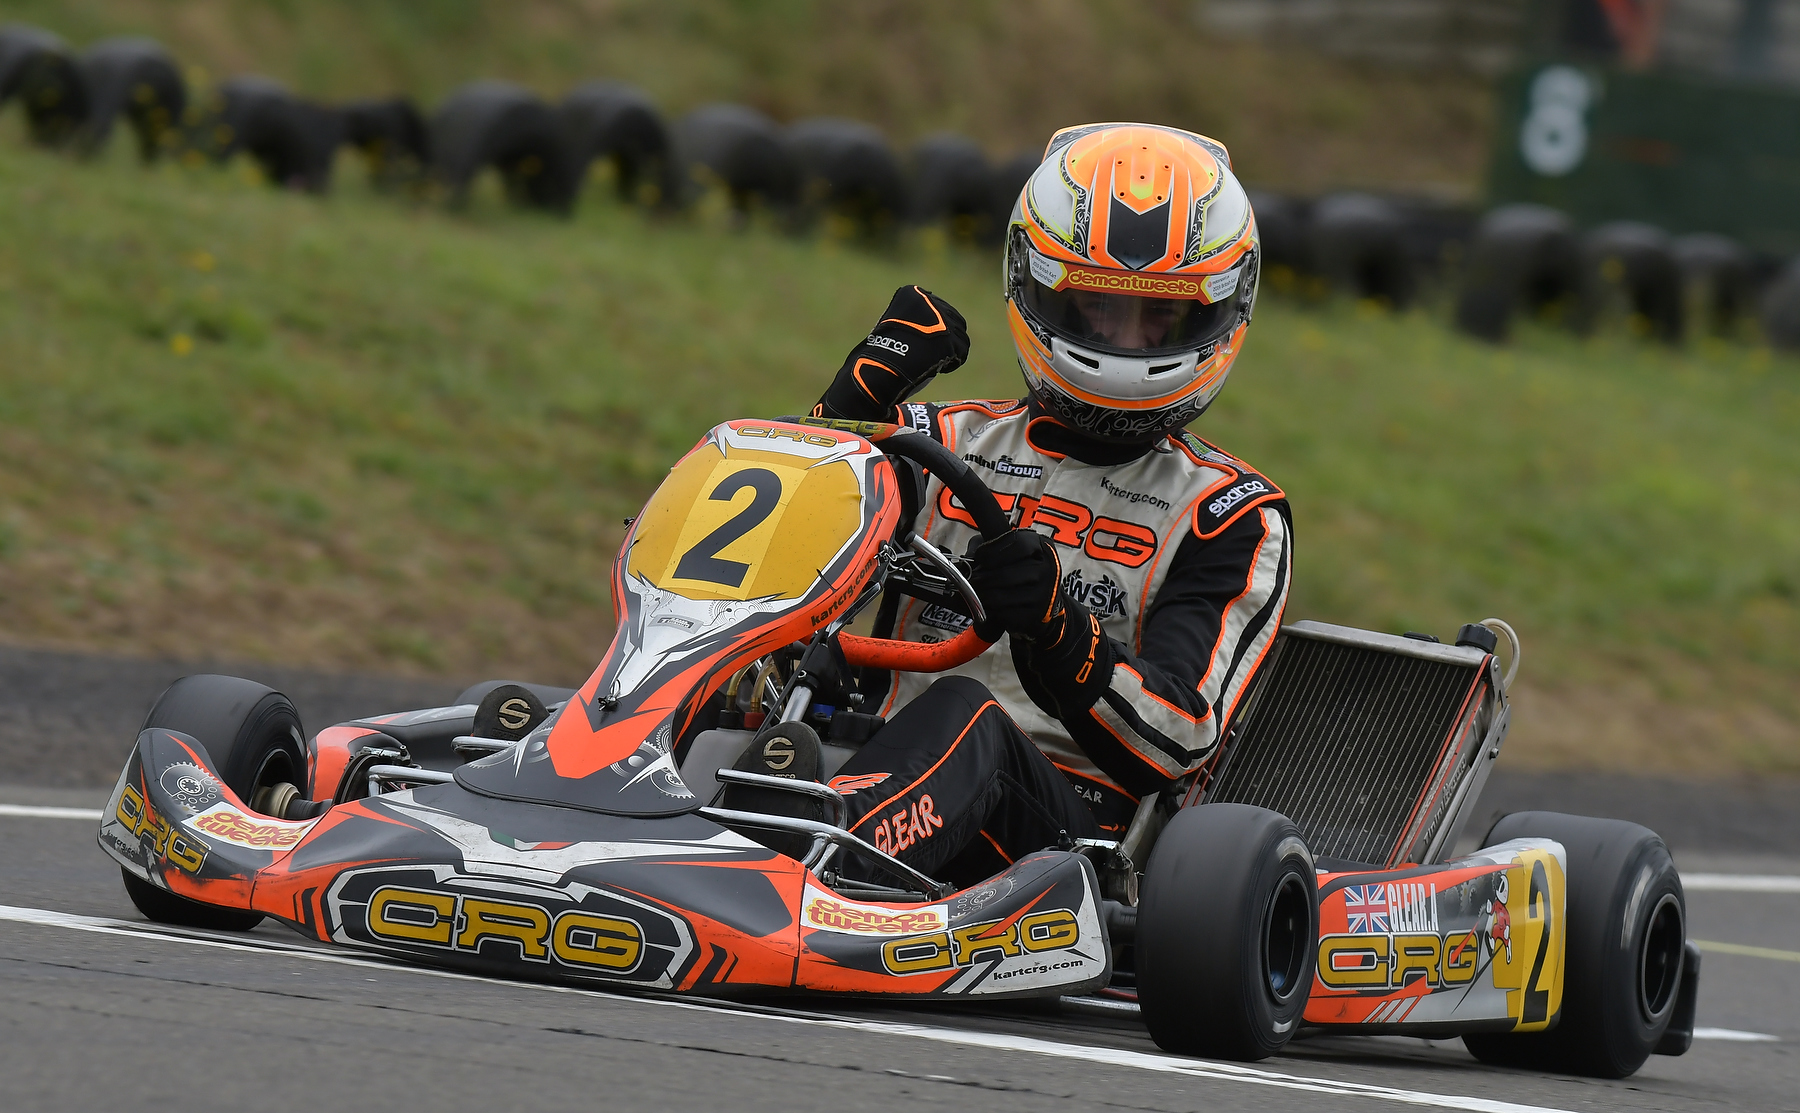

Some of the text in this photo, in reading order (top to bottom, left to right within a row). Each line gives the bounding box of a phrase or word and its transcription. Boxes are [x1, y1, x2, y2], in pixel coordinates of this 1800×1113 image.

[1069, 269, 1199, 295] demontweeks
[866, 333, 909, 356] sparco
[737, 425, 839, 447] CRG
[799, 416, 889, 435] CRG
[907, 403, 932, 437] sparc
[997, 461, 1042, 478] Group
[1208, 480, 1269, 518] sparco
[671, 467, 783, 588] 2
[811, 558, 873, 627] kartcrg.com
[1068, 577, 1128, 617] WSK
[116, 784, 211, 875] CRG
[198, 815, 301, 847] tweeks
[875, 794, 943, 857] GLEAR
[367, 886, 643, 972] CRG
[809, 906, 942, 933] tweeks
[815, 899, 937, 924] demon
[881, 908, 1079, 977] CRG
[1317, 930, 1479, 990] CRG
[1520, 859, 1552, 1025] 2
[993, 959, 1084, 980] kartcrg.com
